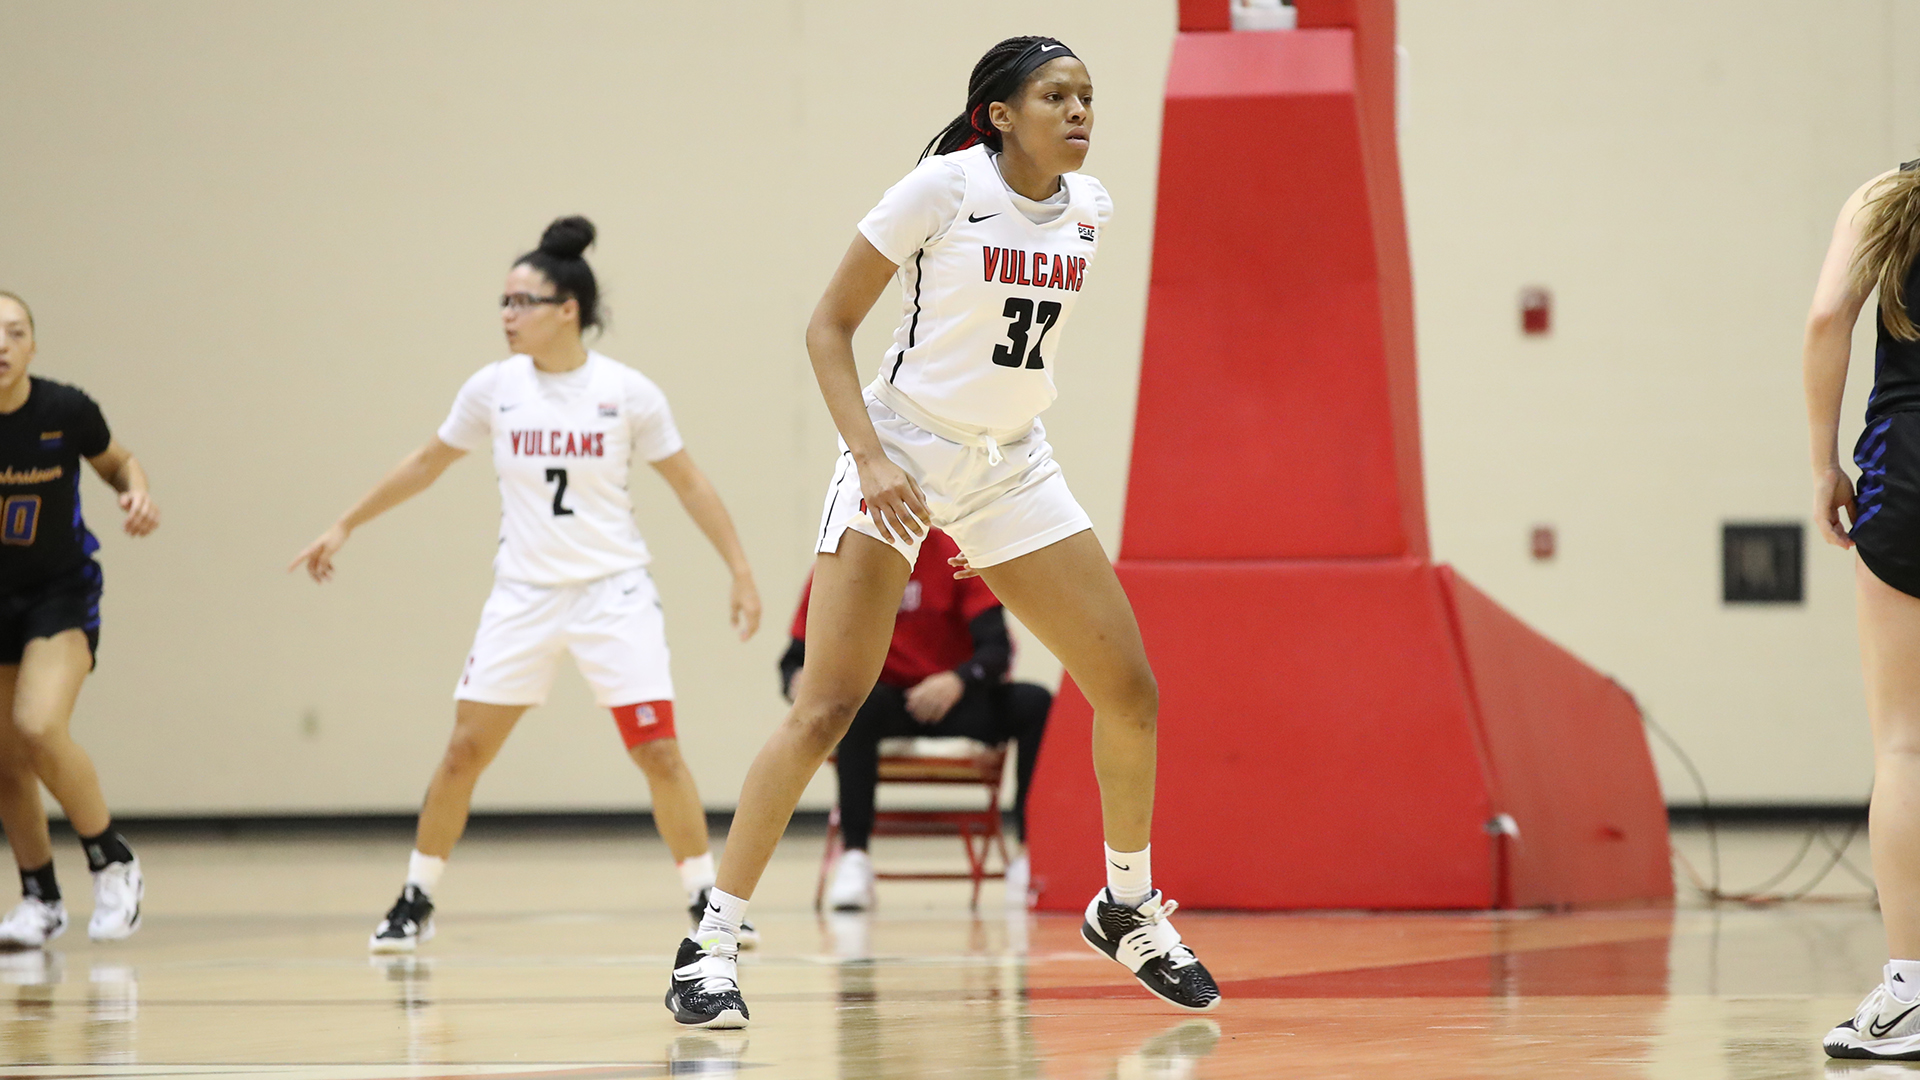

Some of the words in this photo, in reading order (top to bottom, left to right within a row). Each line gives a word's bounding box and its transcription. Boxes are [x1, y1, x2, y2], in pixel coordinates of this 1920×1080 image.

[983, 246, 1086, 292] VULCANS
[992, 297, 1062, 369] 32
[511, 430, 604, 457] VULCANS
[545, 468, 574, 516] 2
[0, 494, 42, 546] 0
